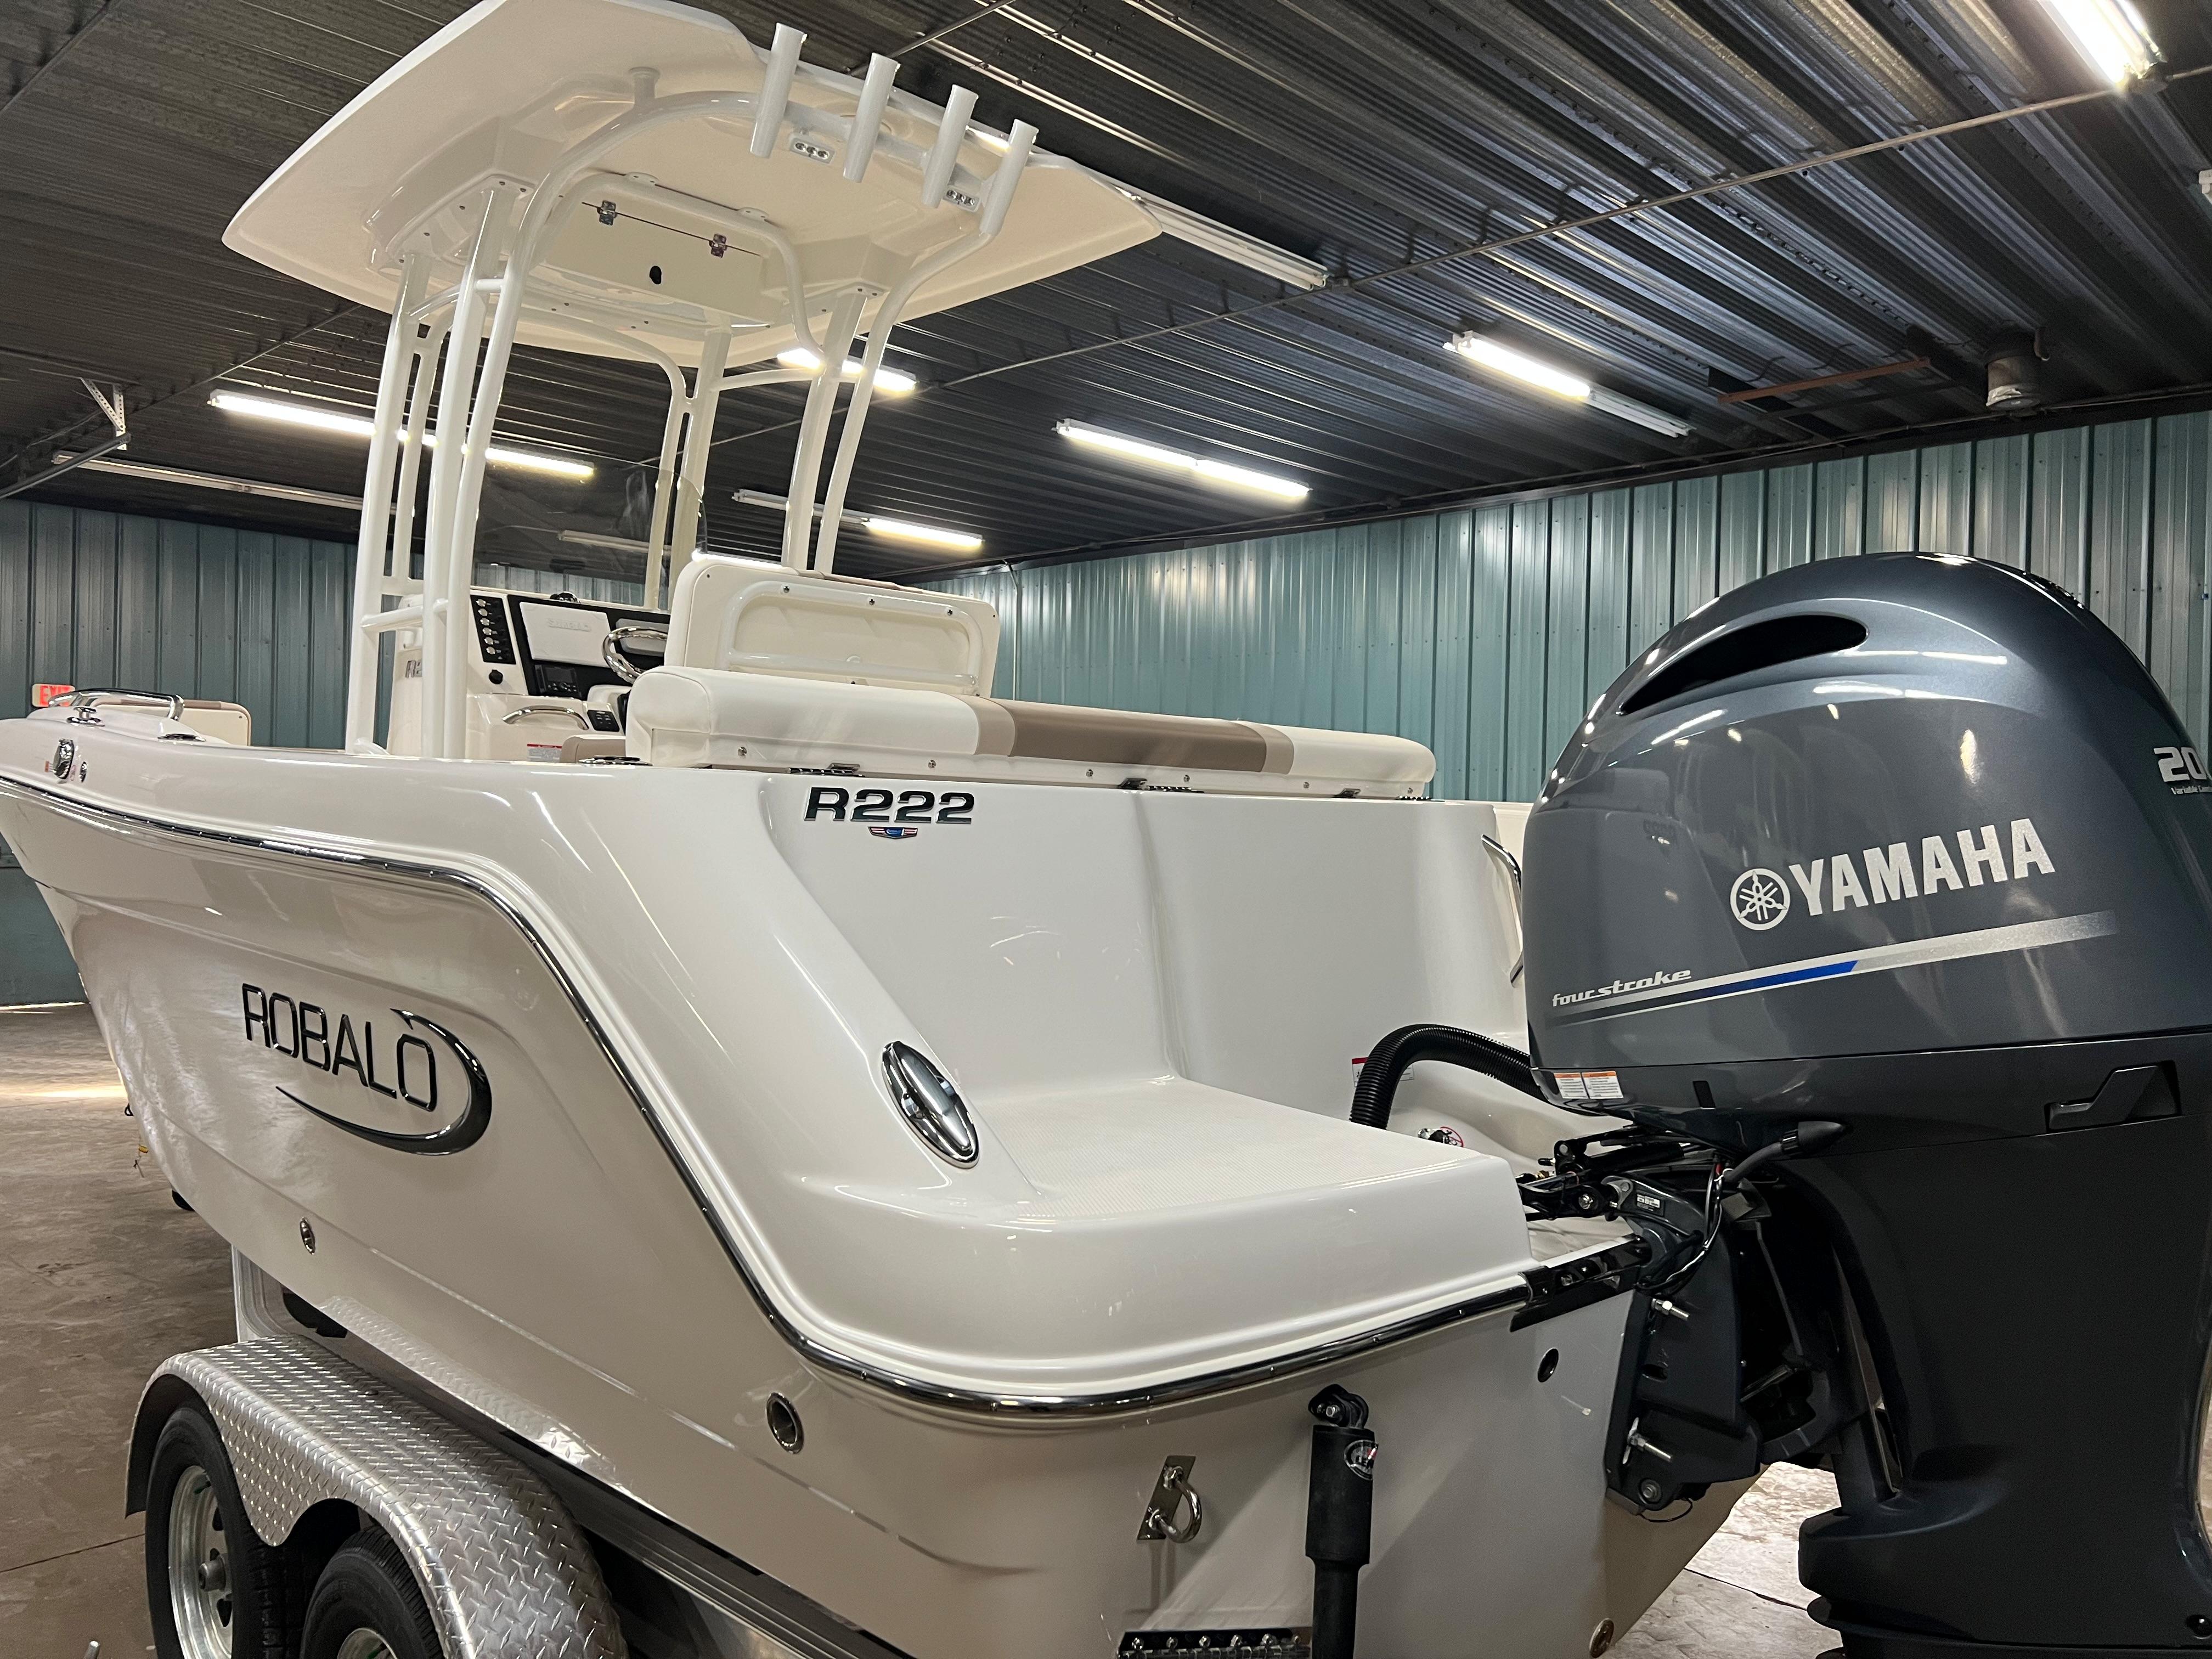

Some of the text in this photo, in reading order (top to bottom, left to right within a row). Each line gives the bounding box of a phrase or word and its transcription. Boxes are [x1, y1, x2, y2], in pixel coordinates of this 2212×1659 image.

[804, 787, 975, 824] R222
[1788, 818, 2055, 916] YAMAHA
[242, 983, 437, 1113] ROBALO
